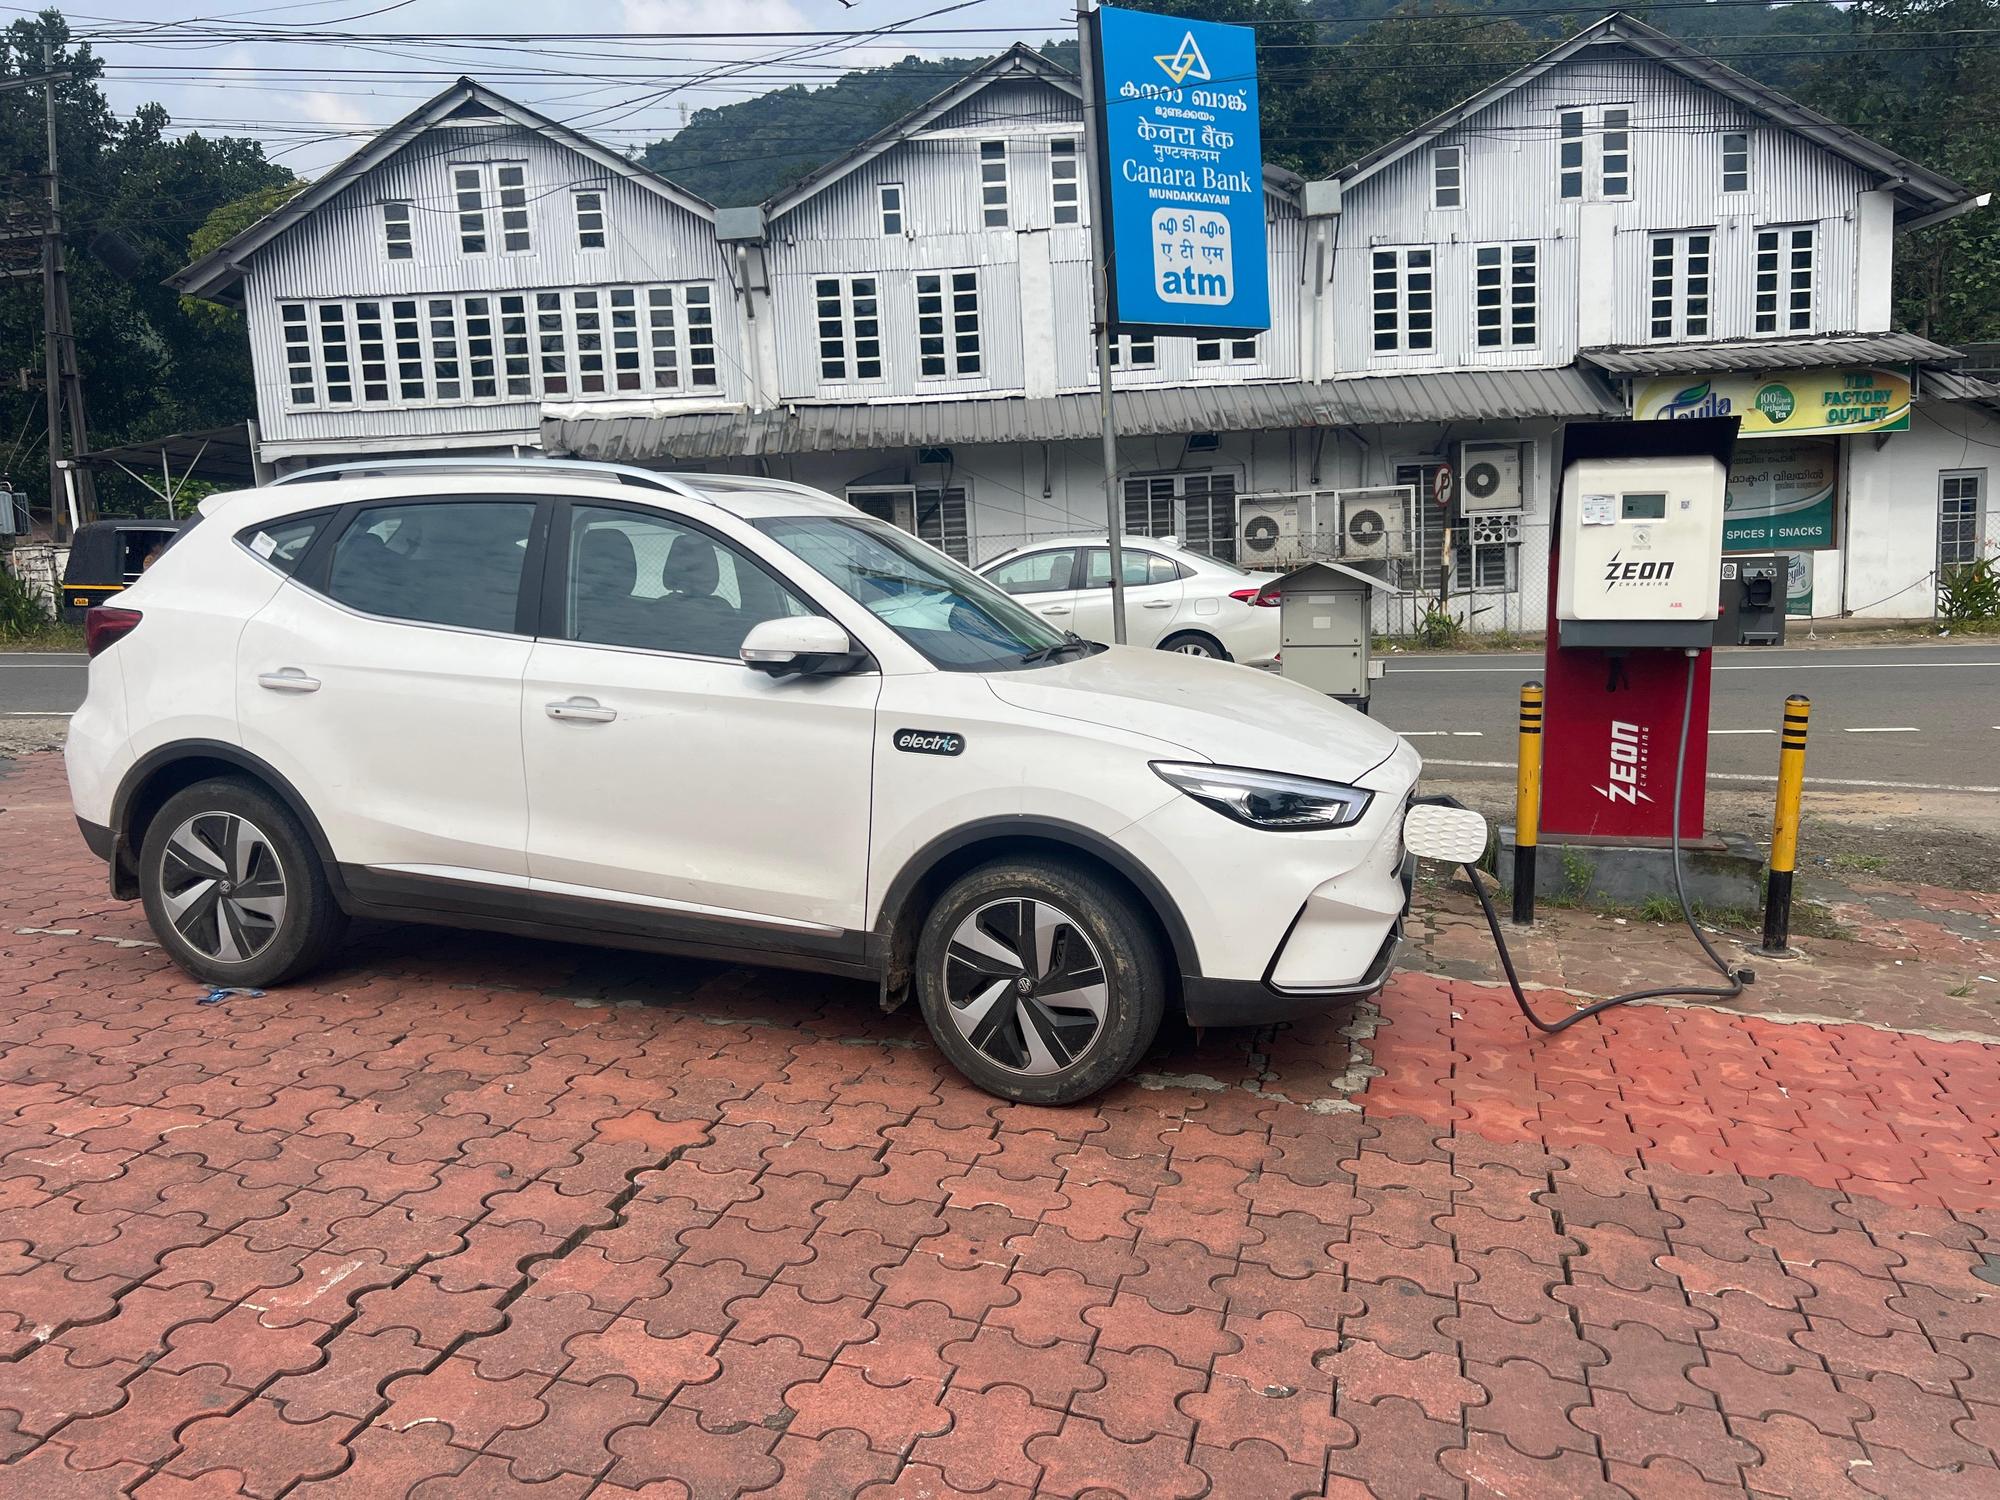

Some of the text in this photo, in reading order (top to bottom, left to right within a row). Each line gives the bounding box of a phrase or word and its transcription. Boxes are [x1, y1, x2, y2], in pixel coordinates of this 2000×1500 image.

[1137, 116, 1234, 149] केनरा बैंक
[1122, 158, 1252, 192] Canara Bank
[1149, 188, 1230, 205] MUNDAKKAYAM
[1159, 218, 1178, 235] എ
[1200, 221, 1225, 238] എം
[1161, 239, 1224, 264] ए टी एम
[1163, 265, 1227, 297] atm
[1823, 390, 1893, 406] FACTORY
[1827, 407, 1889, 423] OUTLET
[1726, 529, 1765, 540] SPICES
[1778, 526, 1823, 537] SNACKS
[1604, 562, 1675, 580] ZEON
[899, 733, 959, 751] electric
[1608, 720, 1639, 805] ZEON
[1640, 727, 1649, 787] CHARGING
